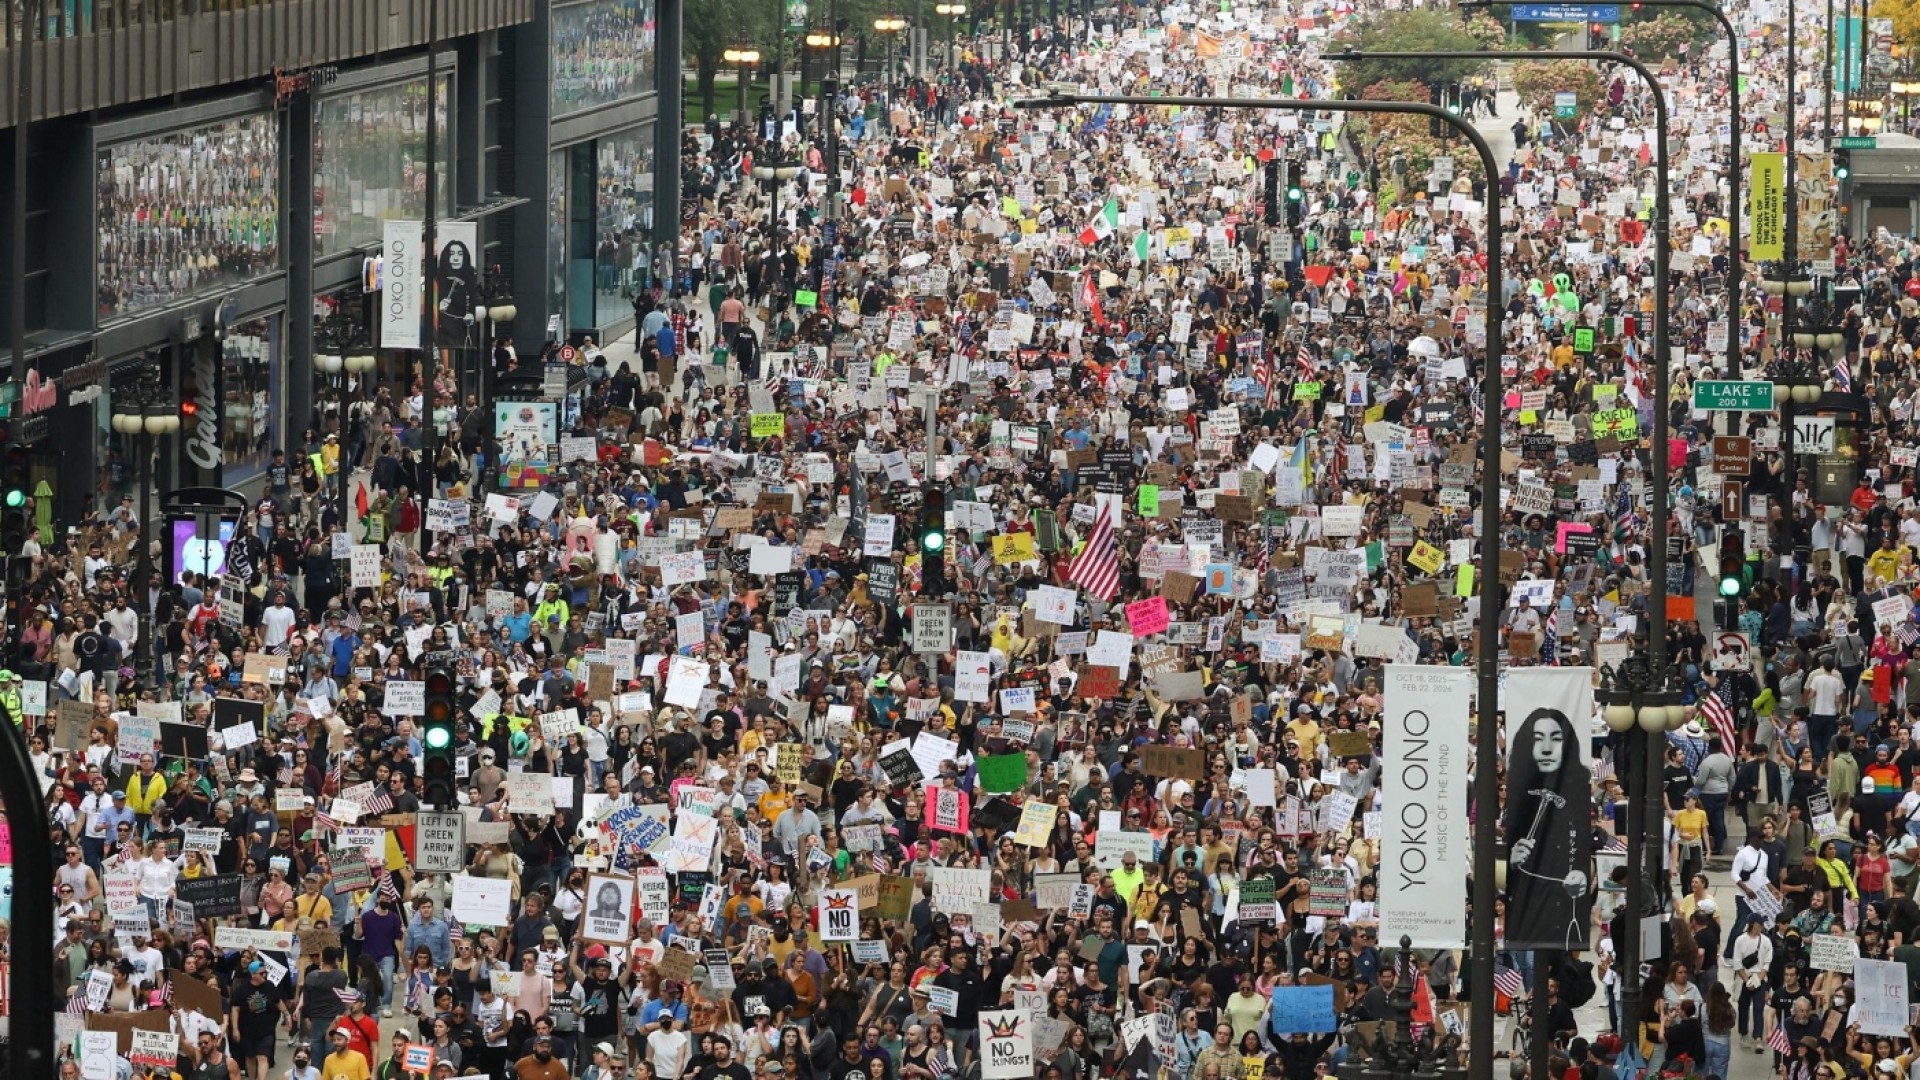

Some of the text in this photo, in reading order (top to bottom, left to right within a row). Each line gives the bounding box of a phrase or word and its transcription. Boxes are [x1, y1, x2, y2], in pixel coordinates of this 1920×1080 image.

[1764, 168, 1772, 209] INSTITUTE
[1756, 199, 1763, 210] OF
[1771, 234, 1778, 245] OF
[389, 240, 405, 323] YOKO ONO
[564, 349, 572, 358] B
[1699, 385, 1769, 397] E LAKE ST
[1718, 398, 1749, 407] 200 N
[1714, 454, 1749, 464] Symphony
[1719, 463, 1743, 472] Center
[1308, 584, 1349, 599] CHINGA
[916, 608, 948, 617] LEFT ON
[919, 619, 944, 627] GREEN
[919, 630, 944, 638] ARROW
[922, 639, 942, 648] ONLY
[1092, 668, 1112, 680] NO
[1396, 674, 1414, 682] OCT
[1080, 680, 1119, 695] KINGS
[1402, 684, 1417, 692] FEB
[909, 700, 922, 710] NO
[1002, 730, 1029, 742] CHICAGO
[677, 790, 716, 810] NO KINGS
[1399, 709, 1430, 892] YOKO ONO
[1437, 743, 1450, 862] MUSIC OF THE MIND
[421, 817, 459, 828] LEFT ON
[186, 827, 206, 836] HANDS
[424, 829, 454, 840] GREEN
[184, 841, 217, 852] CHICAGO
[347, 837, 376, 846] NEEDS
[423, 841, 454, 853] ARROW
[426, 854, 450, 865] ONLY
[649, 894, 662, 903] THE
[648, 911, 664, 921] LIST
[1417, 910, 1428, 918] OF
[828, 910, 851, 930] NO
[1388, 917, 1457, 926] CONTEMPORARY ART
[1388, 924, 1420, 932] CHICAGO
[828, 930, 852, 938] KINGS
[235, 937, 249, 945] GET
[1883, 984, 1902, 999] ICE
[1021, 995, 1044, 1010] NO
[136, 1032, 147, 1042] NO
[991, 1041, 1015, 1058] NO
[993, 1053, 1030, 1068] KINGS!
